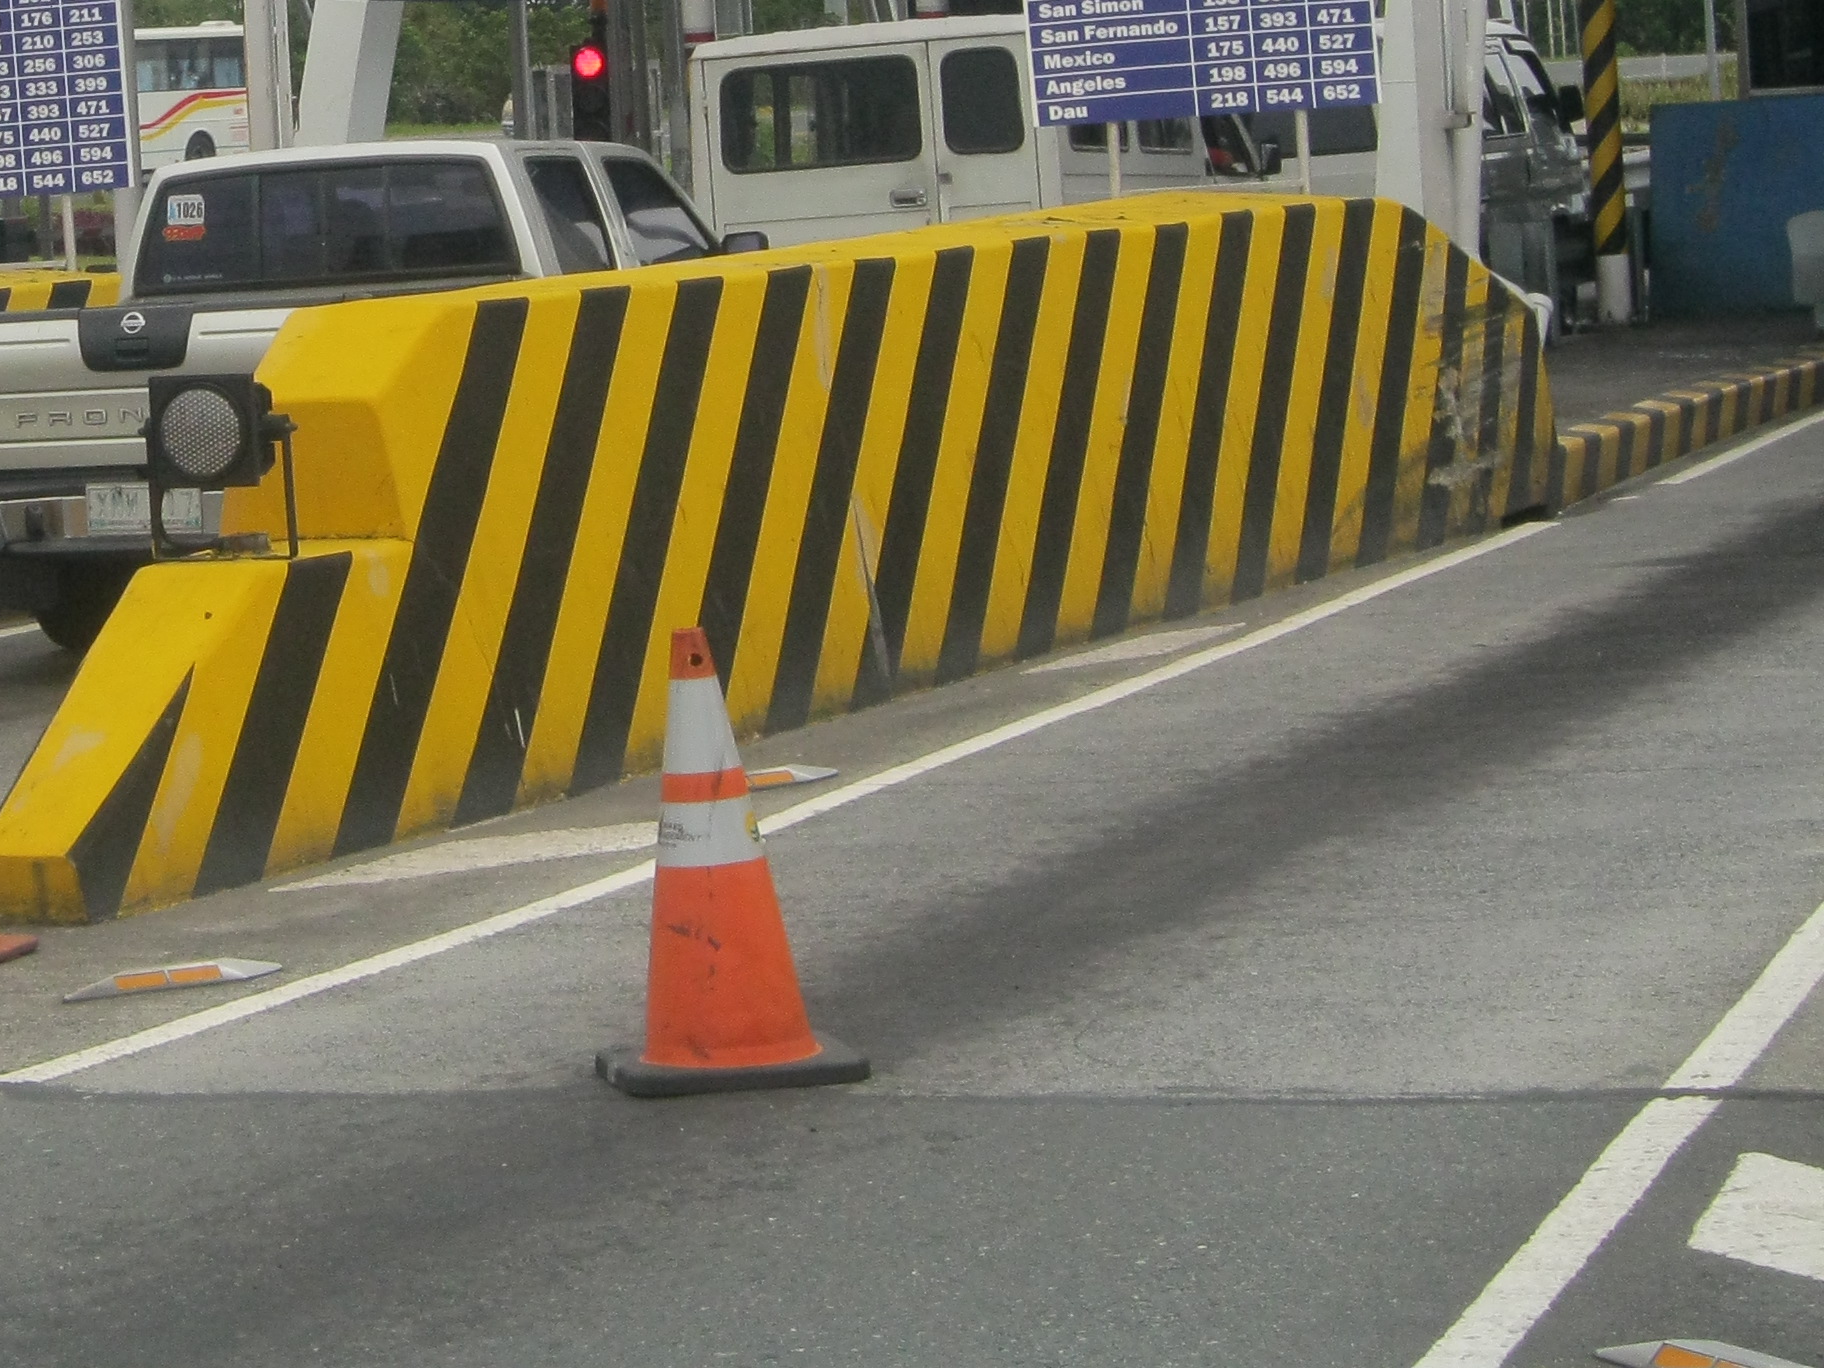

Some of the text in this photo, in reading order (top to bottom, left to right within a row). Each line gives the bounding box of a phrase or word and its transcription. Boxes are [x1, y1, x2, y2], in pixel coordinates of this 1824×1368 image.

[21, 12, 53, 28] 176
[70, 8, 102, 23] 211
[1039, 3, 1077, 19] San
[1041, 7, 1354, 44] San Fernando 157 393 471
[22, 35, 54, 50] 210
[72, 31, 104, 45] 253
[1044, 33, 1356, 69] Mexico 175 440 527
[24, 58, 55, 73] 256
[74, 54, 105, 68] 306
[26, 81, 58, 96] 333
[75, 77, 107, 92] 399
[1047, 59, 1358, 96] Angeles 198 496 594
[28, 104, 60, 119] 393
[77, 100, 109, 115] 471
[1049, 84, 1360, 120] Dau 218 544 652
[30, 128, 61, 142] 440
[78, 123, 110, 138] 527
[31, 150, 63, 165] 496
[80, 146, 112, 161] 594
[33, 174, 65, 188] 544
[82, 170, 114, 184] 652
[176, 202, 203, 218] 1026
[16, 408, 143, 428] FRON
